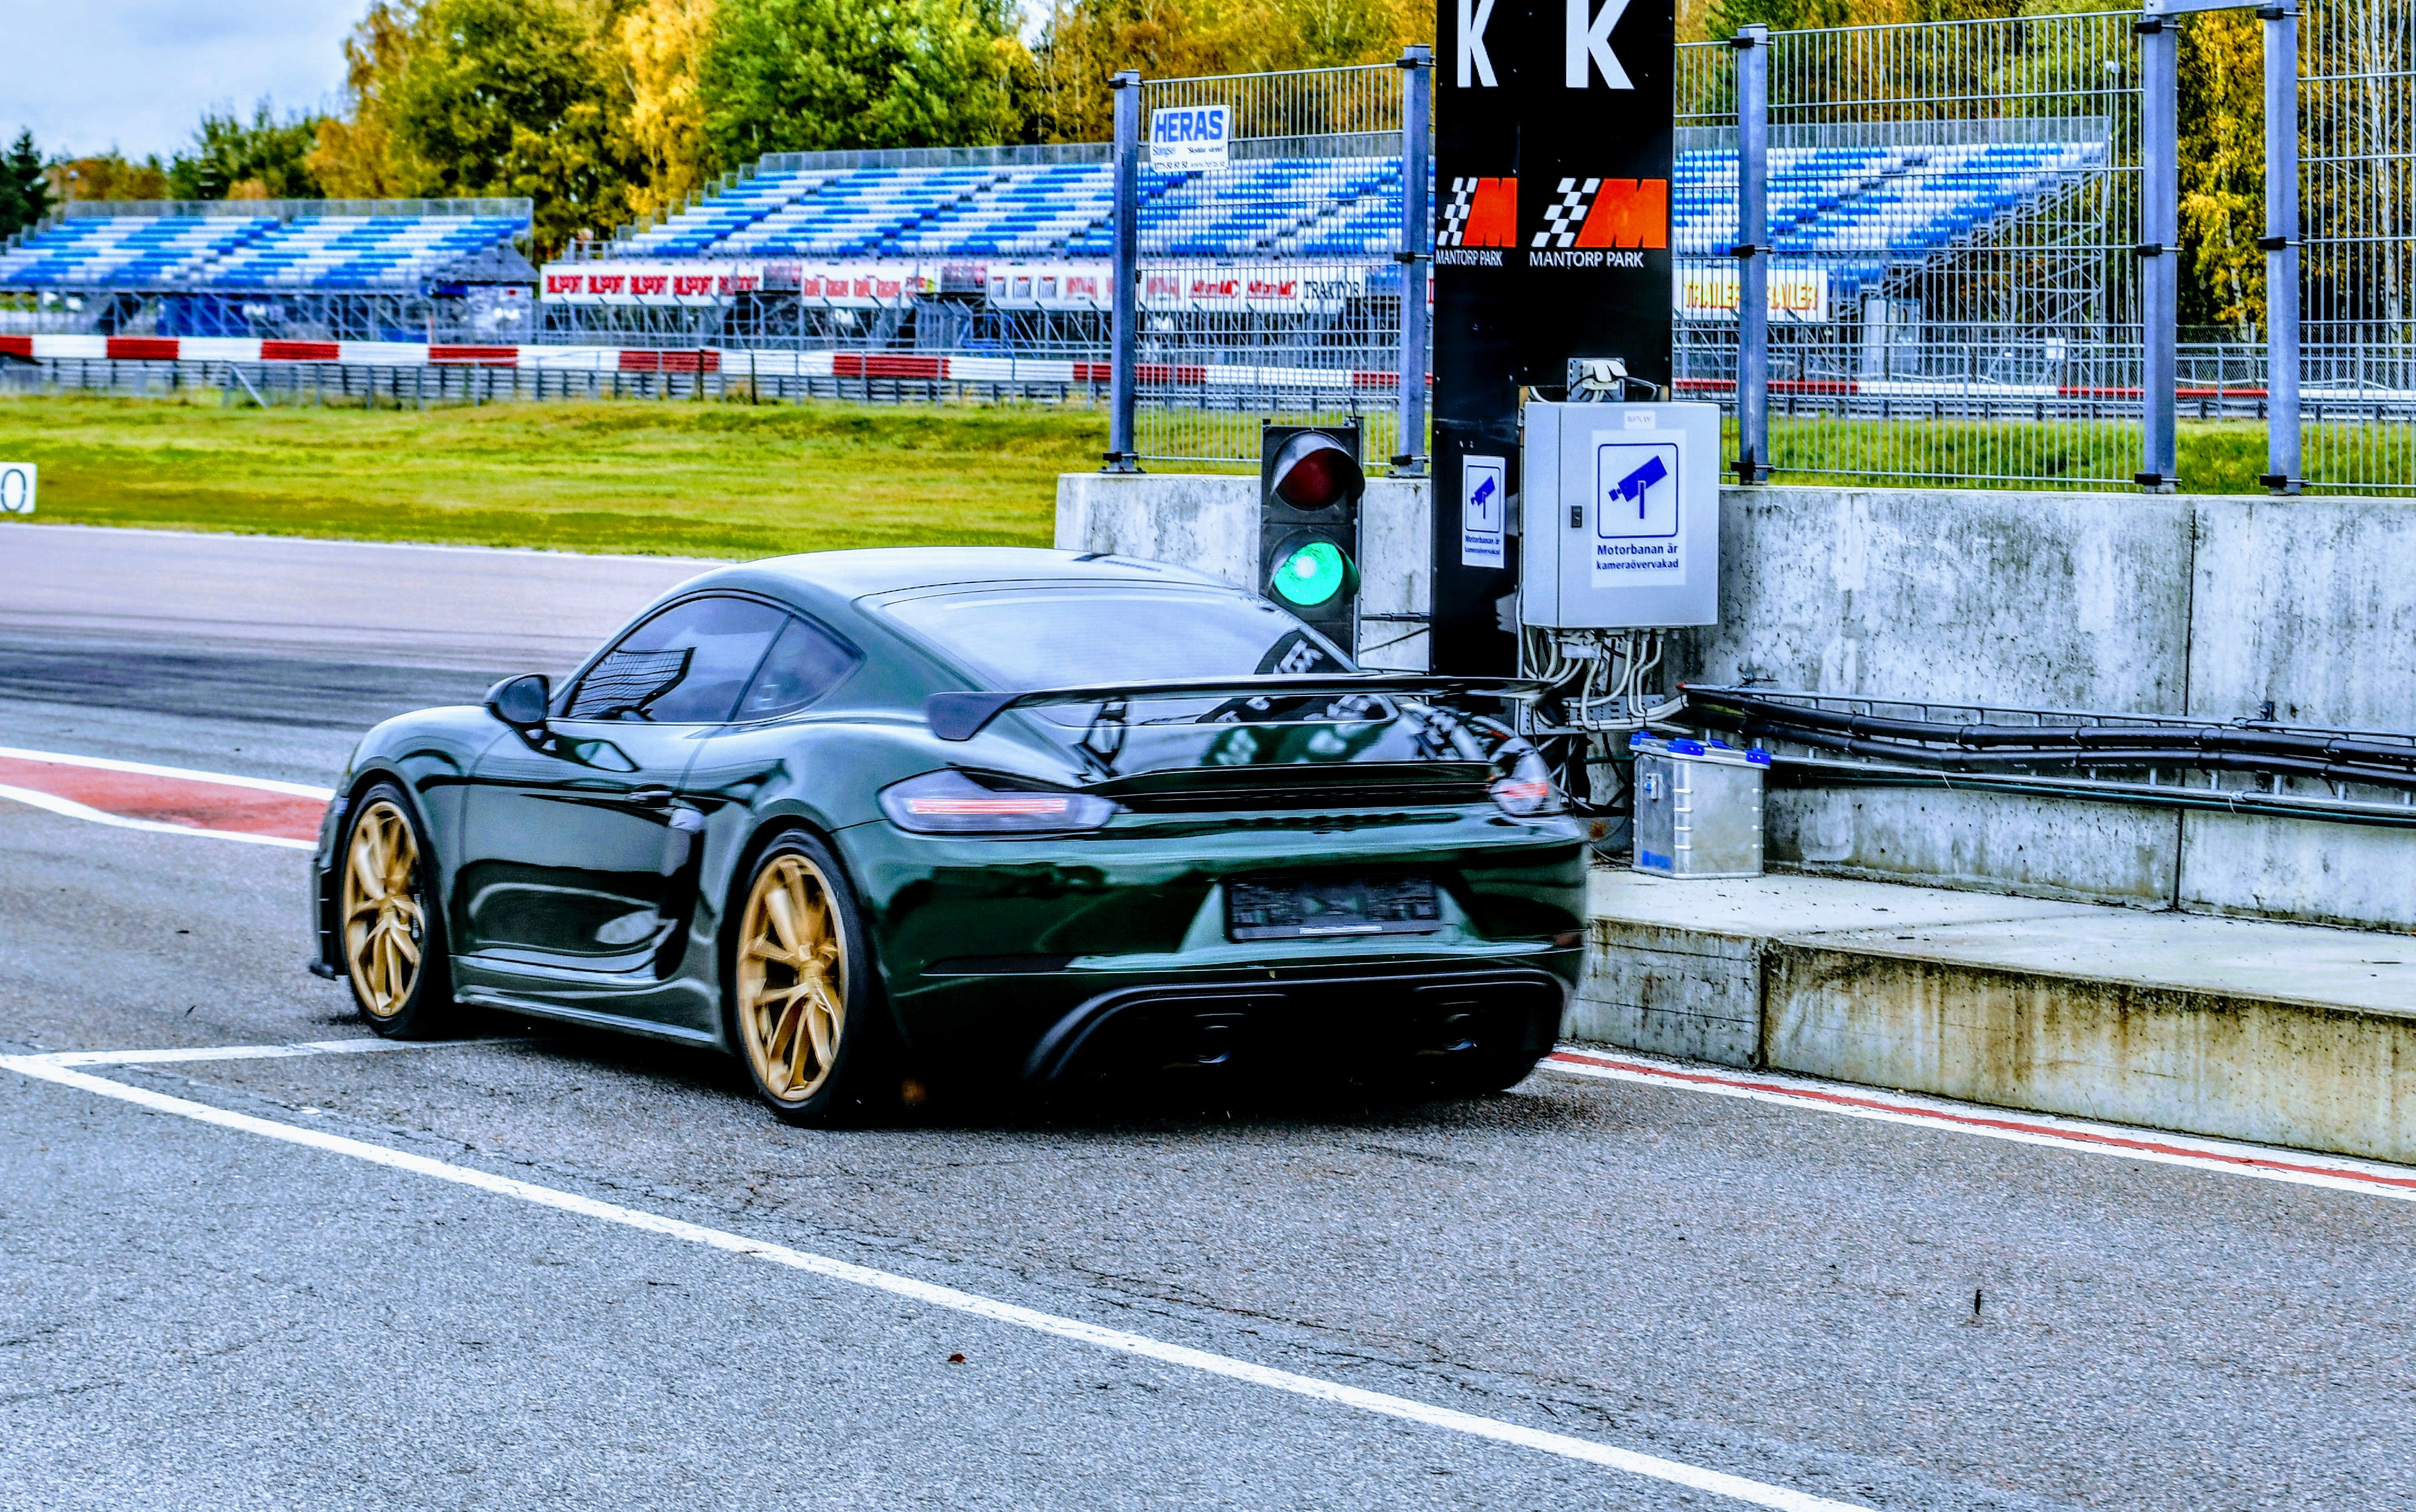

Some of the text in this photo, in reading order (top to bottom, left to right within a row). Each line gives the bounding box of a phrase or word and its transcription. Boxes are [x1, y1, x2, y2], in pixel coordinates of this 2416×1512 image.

[1154, 110, 1223, 142] HERAS
[1435, 249, 1503, 267] MANTORP PARK
[1529, 250, 1645, 268] MANTORP PARK
[1597, 542, 1679, 555] Motorbanan är
[1596, 558, 1679, 570] kameraövervakad
